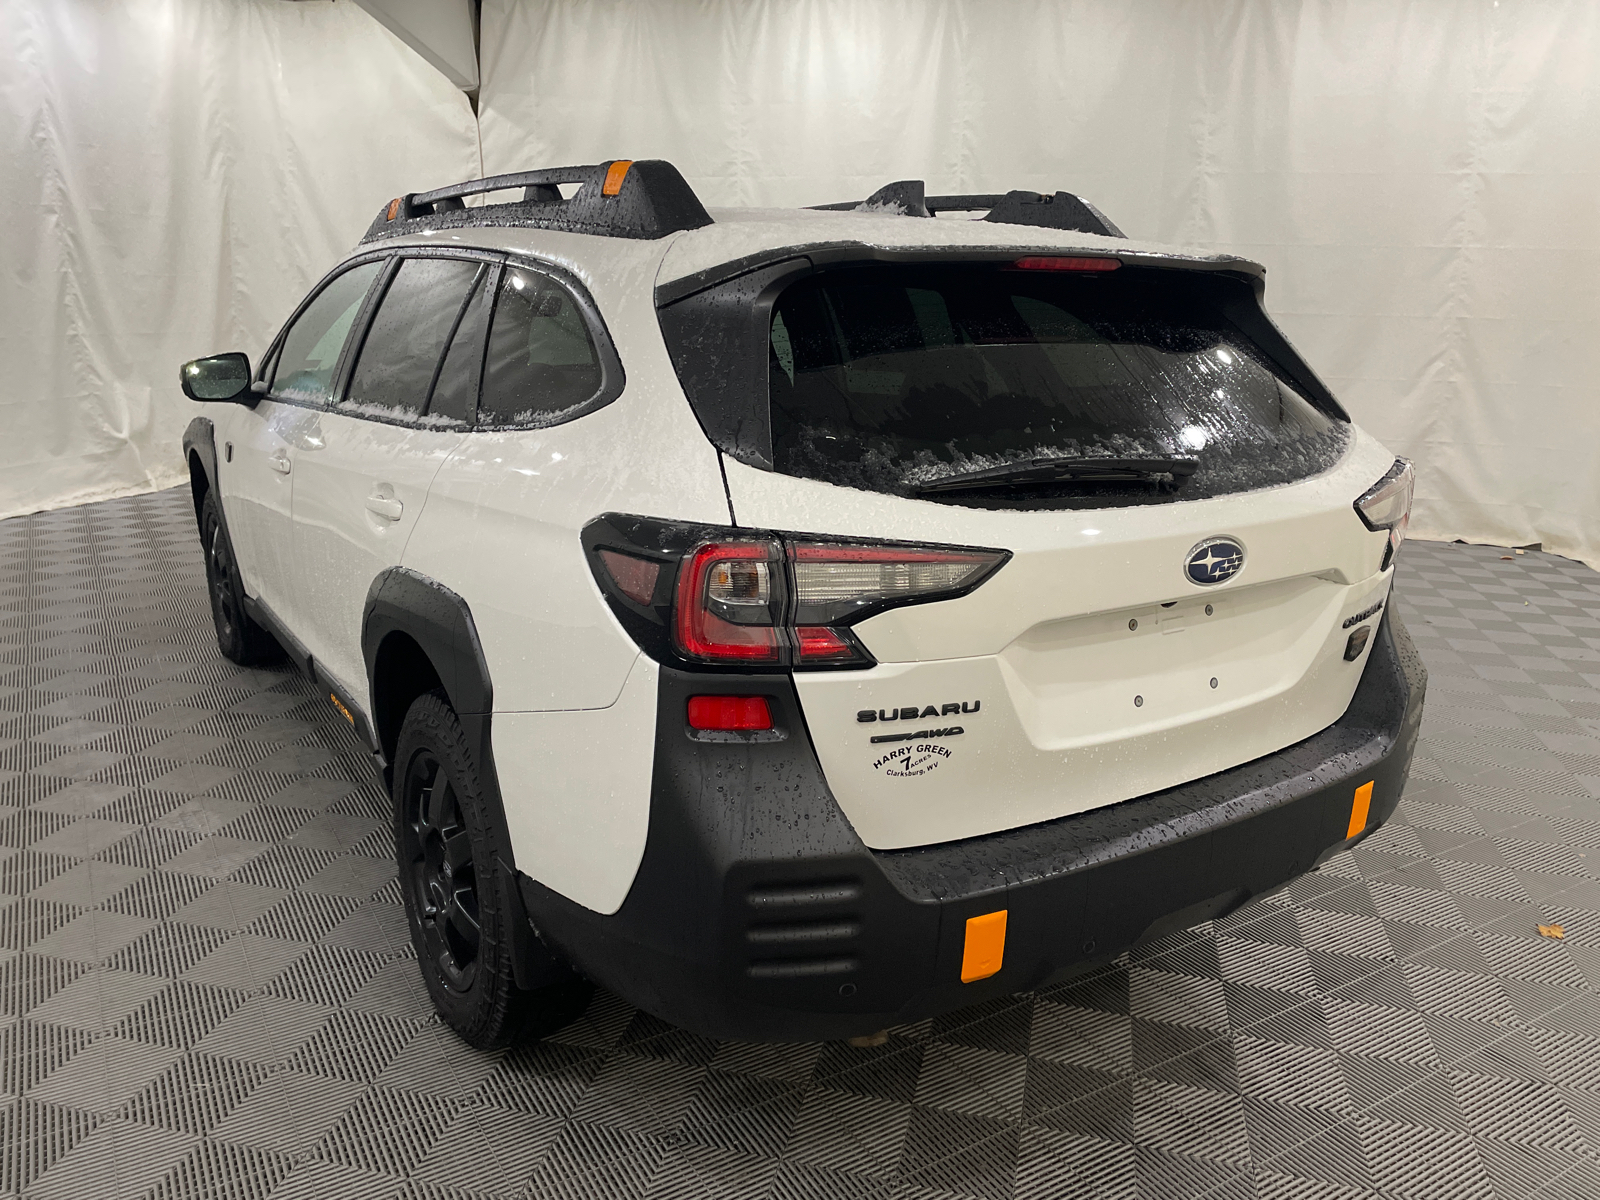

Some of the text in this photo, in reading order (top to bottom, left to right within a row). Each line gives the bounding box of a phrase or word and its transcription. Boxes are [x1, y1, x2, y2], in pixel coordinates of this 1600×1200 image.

[856, 700, 981, 723] SUBARU
[905, 726, 965, 741] AWD
[873, 744, 952, 770] HARRY GREEN
[900, 753, 932, 771] 7 ACRES
[886, 761, 939, 777] Clarksburg, WV
